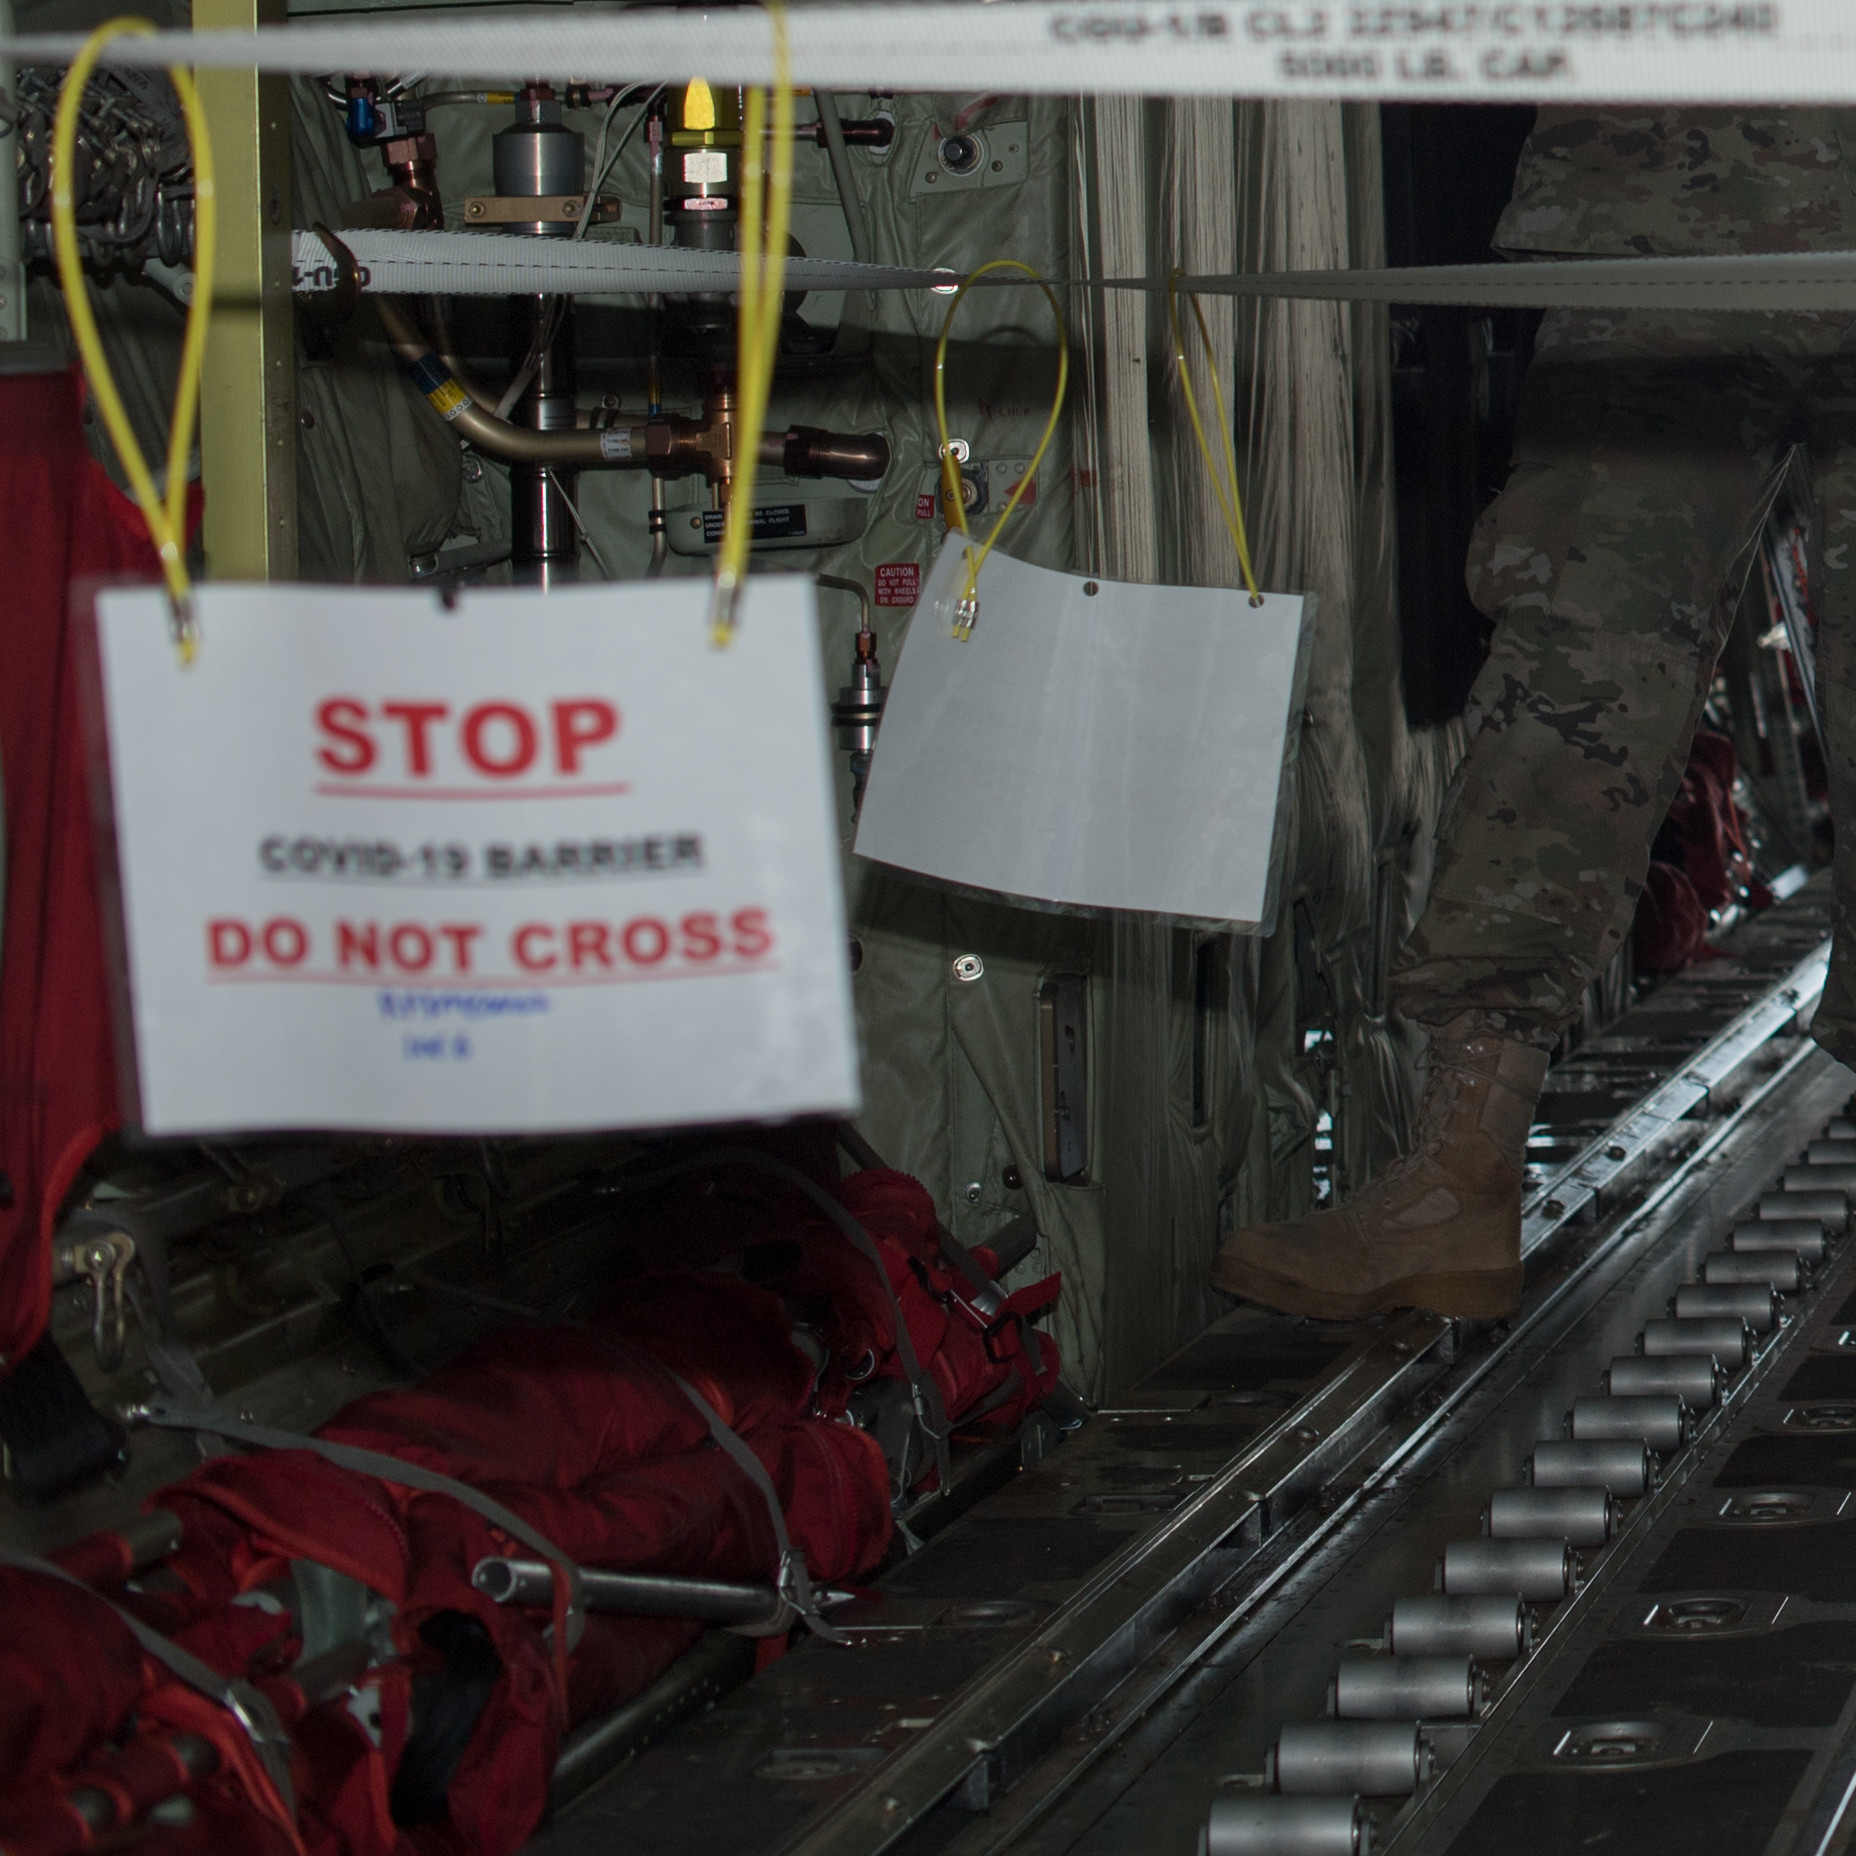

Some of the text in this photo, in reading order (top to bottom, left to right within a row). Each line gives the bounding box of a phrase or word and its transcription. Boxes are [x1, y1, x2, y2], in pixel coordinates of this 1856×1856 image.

[880, 567, 915, 578] CAUTION
[878, 578, 917, 587] DO NOT PULL
[896, 587, 917, 595] WHEELS
[880, 596, 915, 604] ON GROUND
[315, 697, 620, 779] STOP
[259, 830, 706, 881] COVID-19 BARRIER
[206, 907, 775, 974] DO NOT CROSS
